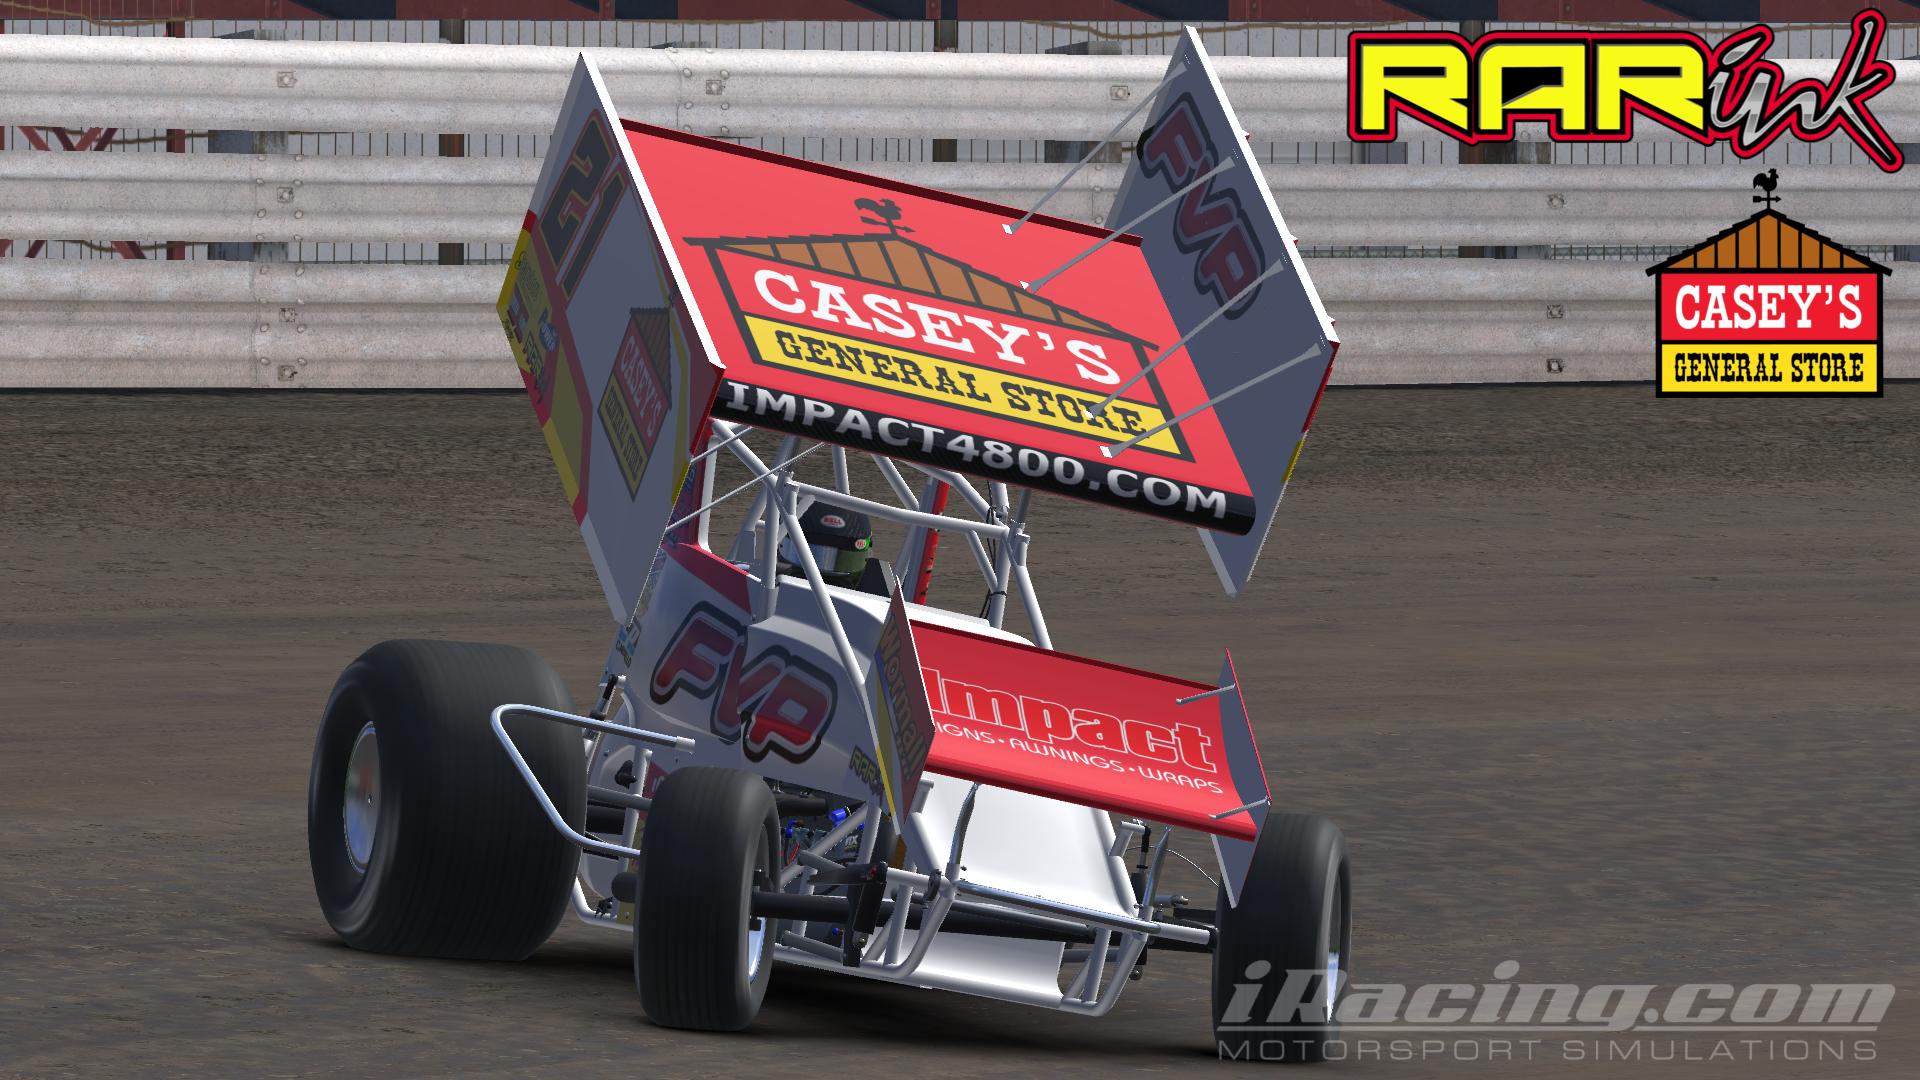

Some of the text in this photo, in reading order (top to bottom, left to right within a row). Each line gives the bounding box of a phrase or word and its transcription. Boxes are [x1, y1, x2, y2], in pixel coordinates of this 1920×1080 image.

[539, 114, 628, 301] 21
[1139, 95, 1263, 316] FVP
[754, 269, 1121, 386] CASEY'S
[776, 329, 1151, 438] GENERAL STORE
[620, 335, 662, 438] CASEY'S
[726, 380, 1229, 519] IMPACT4800.COM
[652, 606, 834, 759] FVP
[921, 667, 1216, 773] Impact
[936, 722, 1224, 795] IGNS AWNINGS WRAPS
